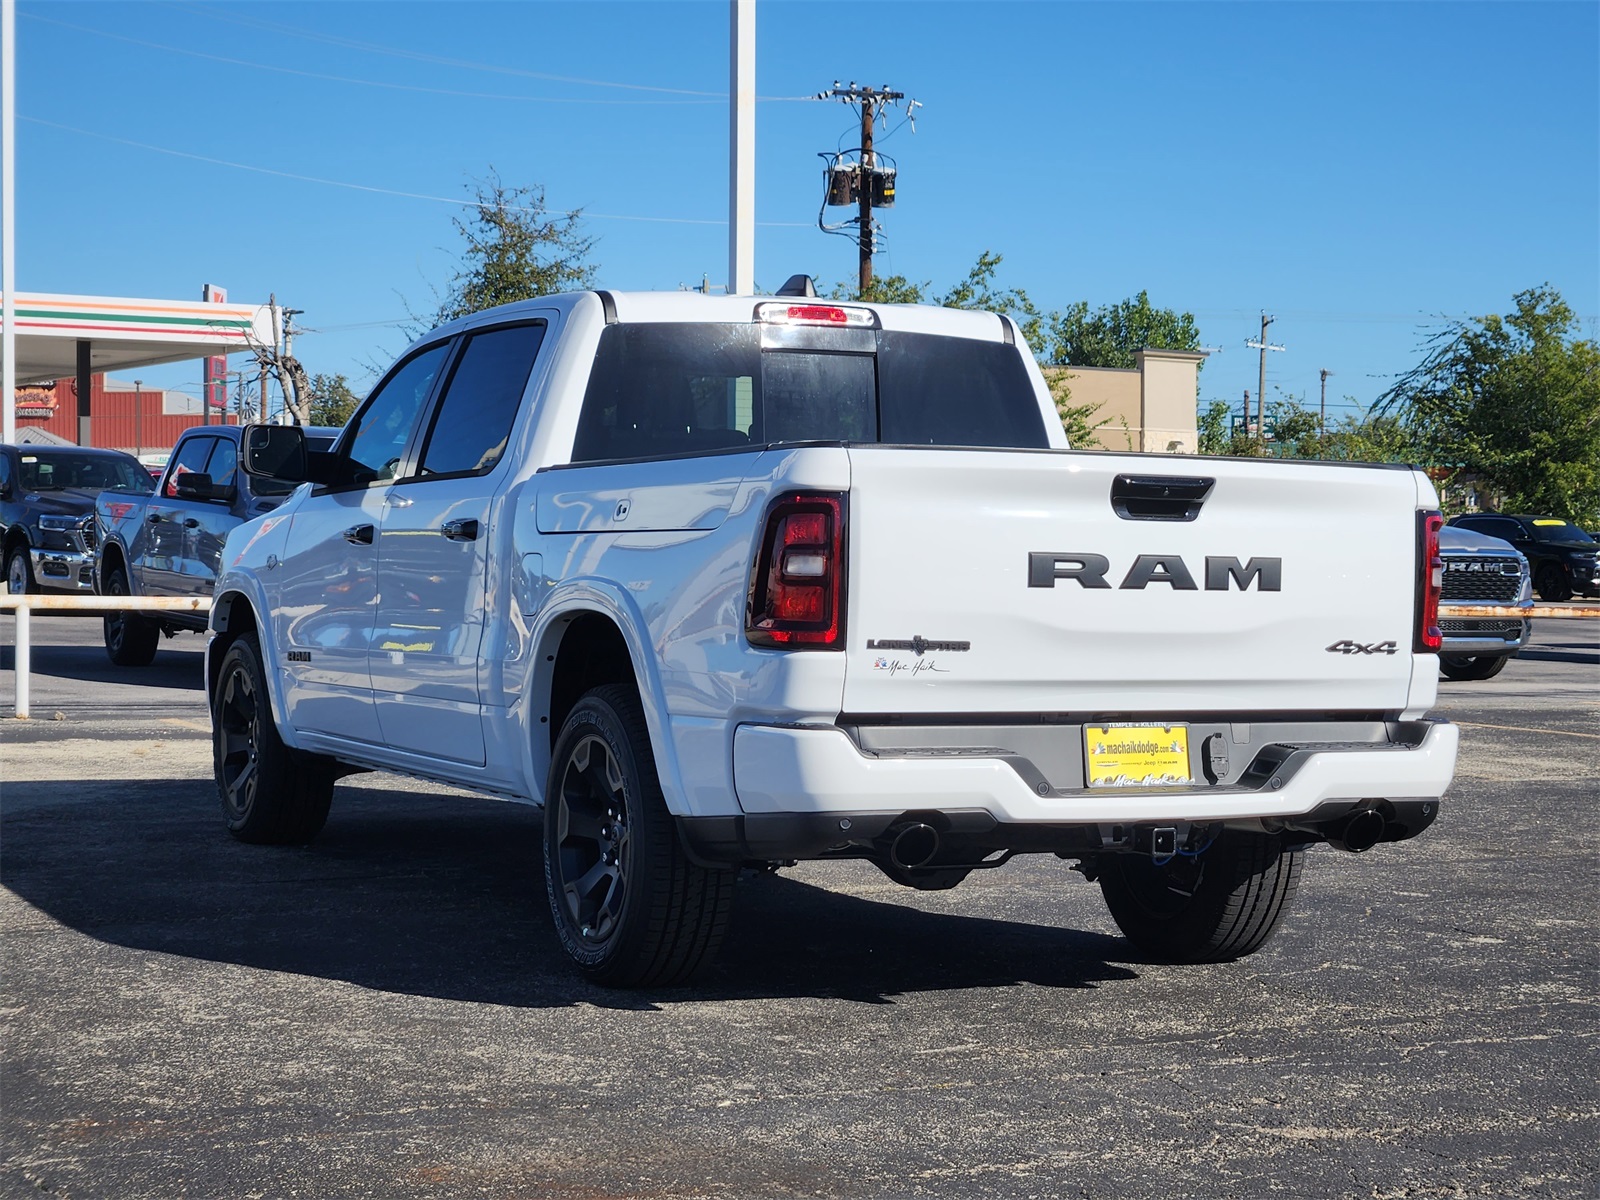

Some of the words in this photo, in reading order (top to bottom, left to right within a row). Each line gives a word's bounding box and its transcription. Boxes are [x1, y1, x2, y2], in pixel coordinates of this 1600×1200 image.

[1028, 552, 1282, 592] RAM
[1449, 562, 1500, 572] RAM
[1325, 640, 1399, 655] 4x4
[287, 651, 312, 662] RAM
[888, 659, 910, 676] Mac
[912, 658, 950, 676] Haik
[1107, 741, 1170, 756] machaikdodge.com
[1114, 774, 1138, 787] Mac
